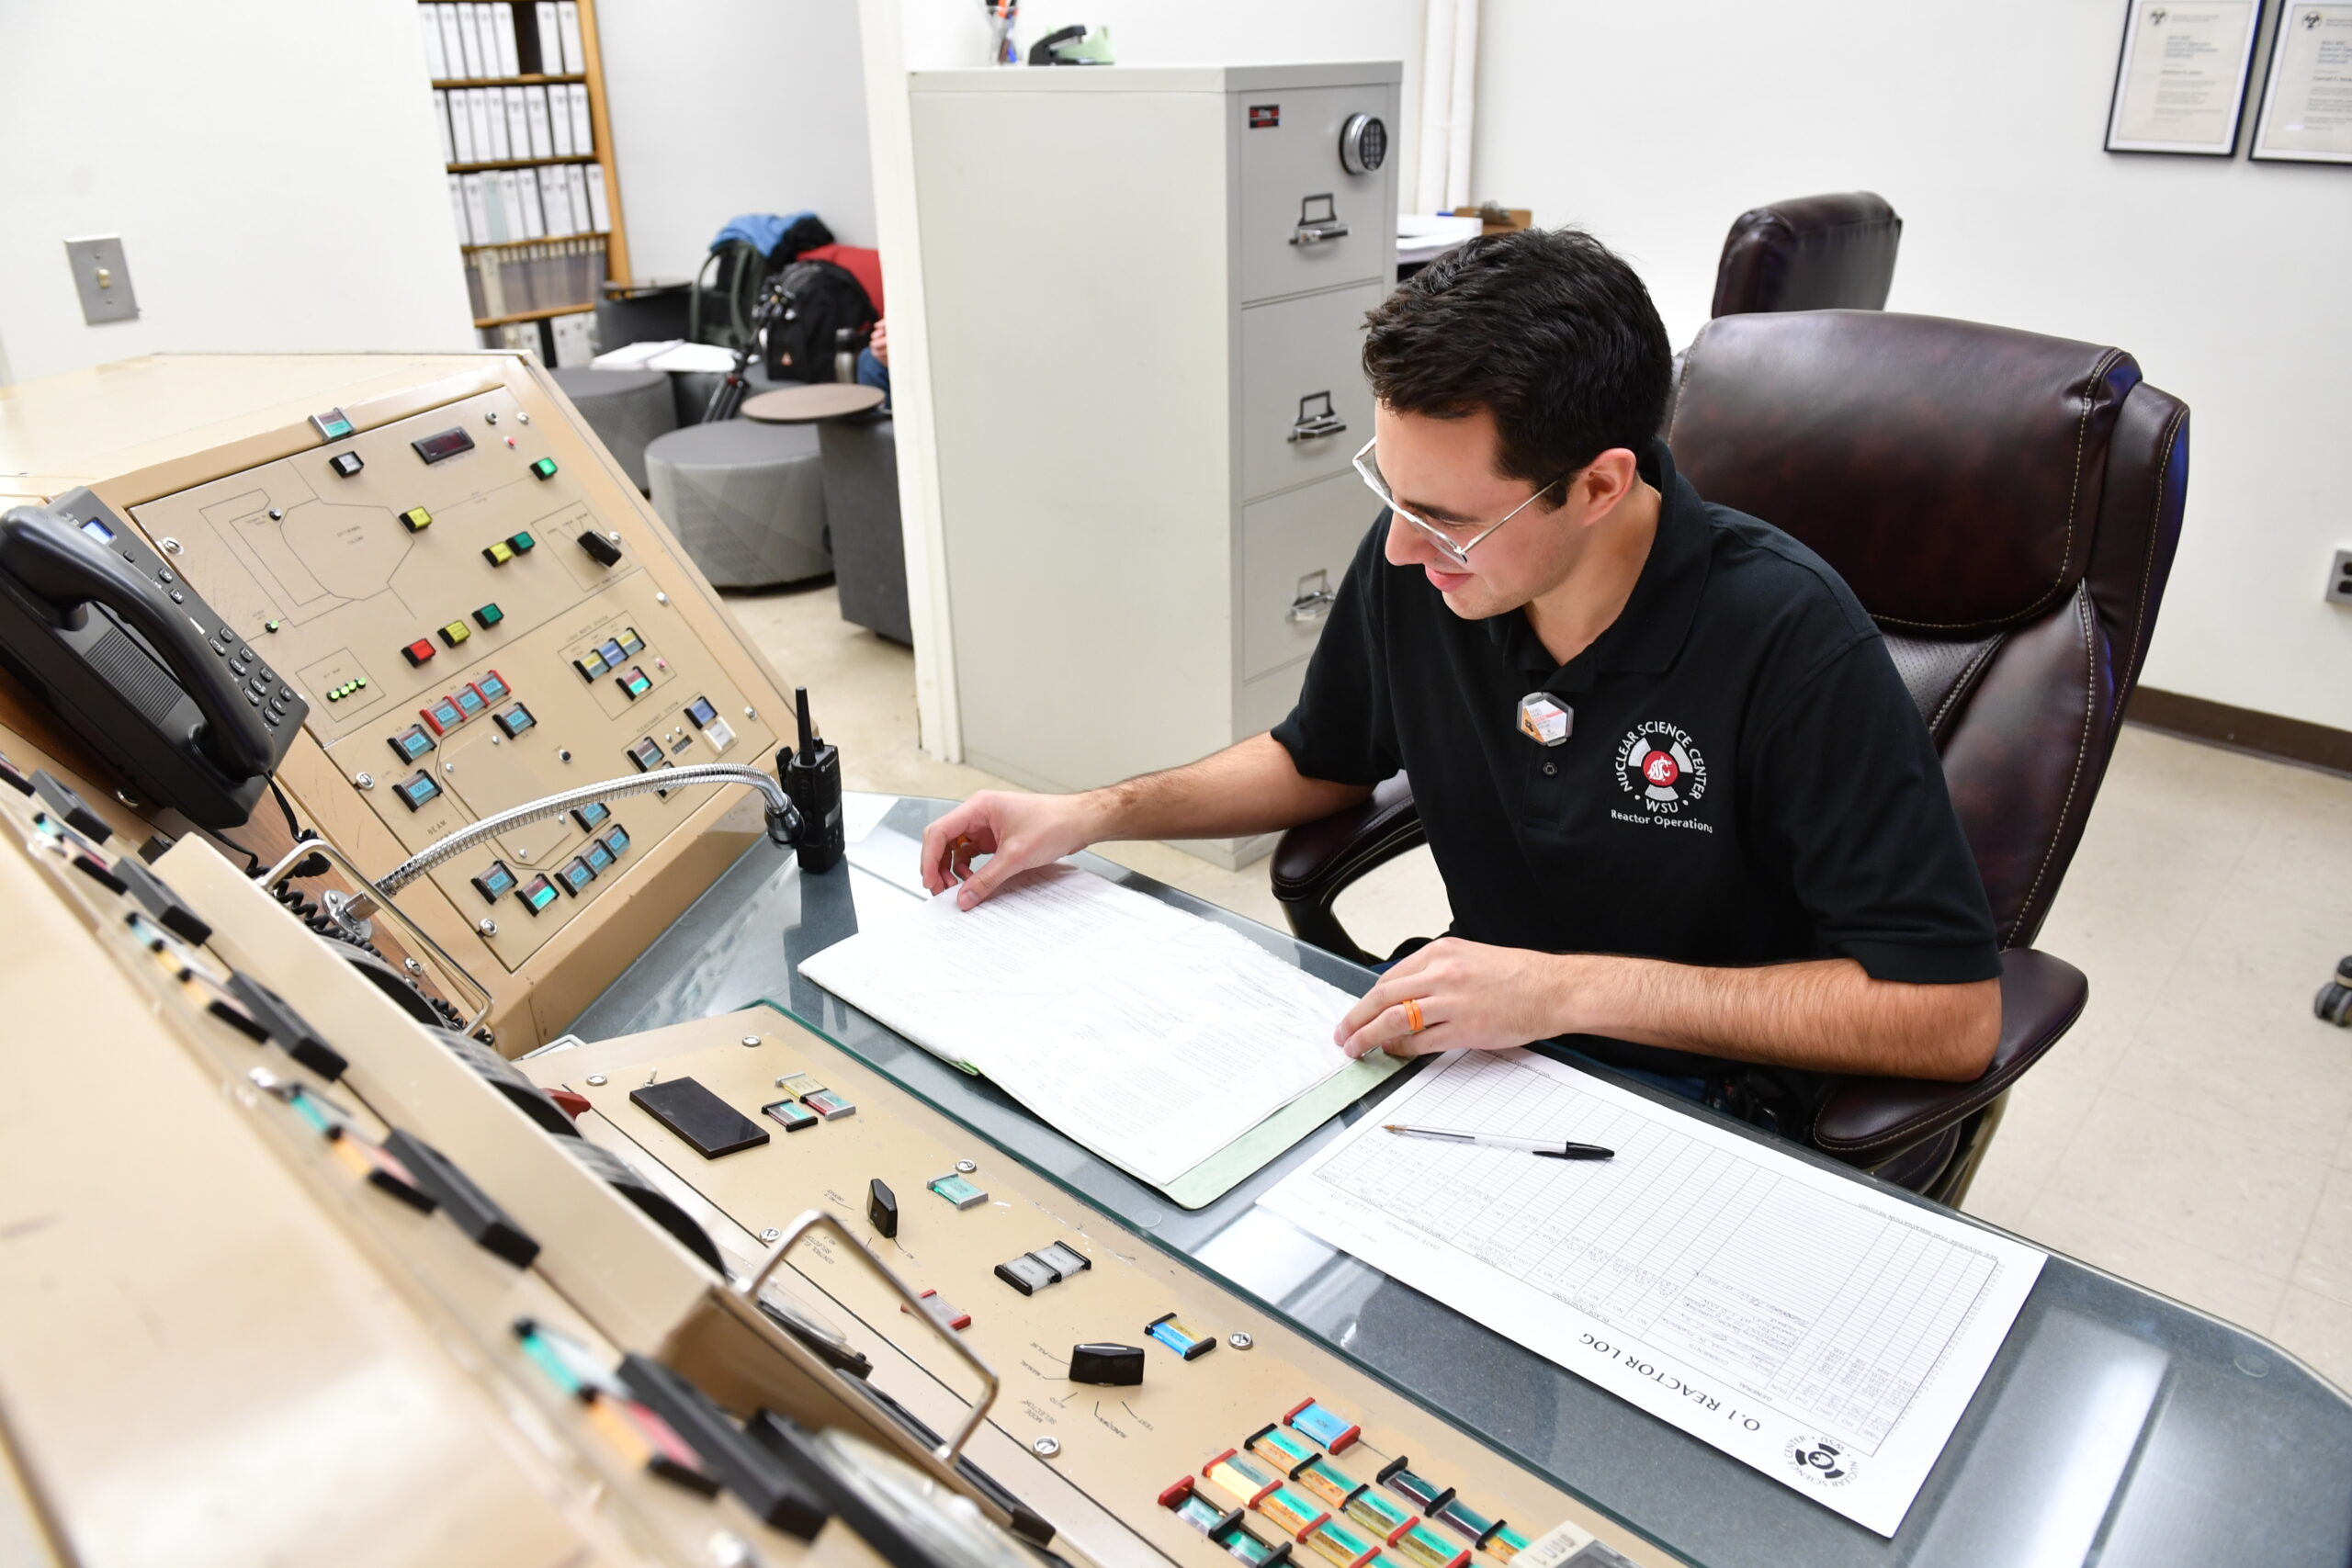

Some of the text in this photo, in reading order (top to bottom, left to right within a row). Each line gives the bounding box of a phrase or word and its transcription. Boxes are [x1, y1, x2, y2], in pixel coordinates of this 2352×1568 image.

[1615, 721, 1707, 800] NUCLEAR SCIENCE CENTER
[1645, 799, 1679, 813] WSU
[428, 820, 447, 835] BEAM
[1611, 809, 1713, 833] Reactor Operations
[1028, 1340, 1050, 1357] PULSE
[1577, 1331, 1623, 1359] LOG
[1018, 1359, 1043, 1377] MANUAL
[1622, 1354, 1723, 1412] REACTOR
[1019, 1397, 1058, 1426] SELECTOR
[1047, 1395, 1067, 1410] AUTO
[1023, 1407, 1045, 1424] MODE
[1136, 1416, 1155, 1431] TEST
[1096, 1416, 1129, 1439] RUNDOWN
[1820, 1436, 1845, 1451] WSU
[1784, 1435, 1860, 1488] NUCLEAR SCIENCE CENTER
